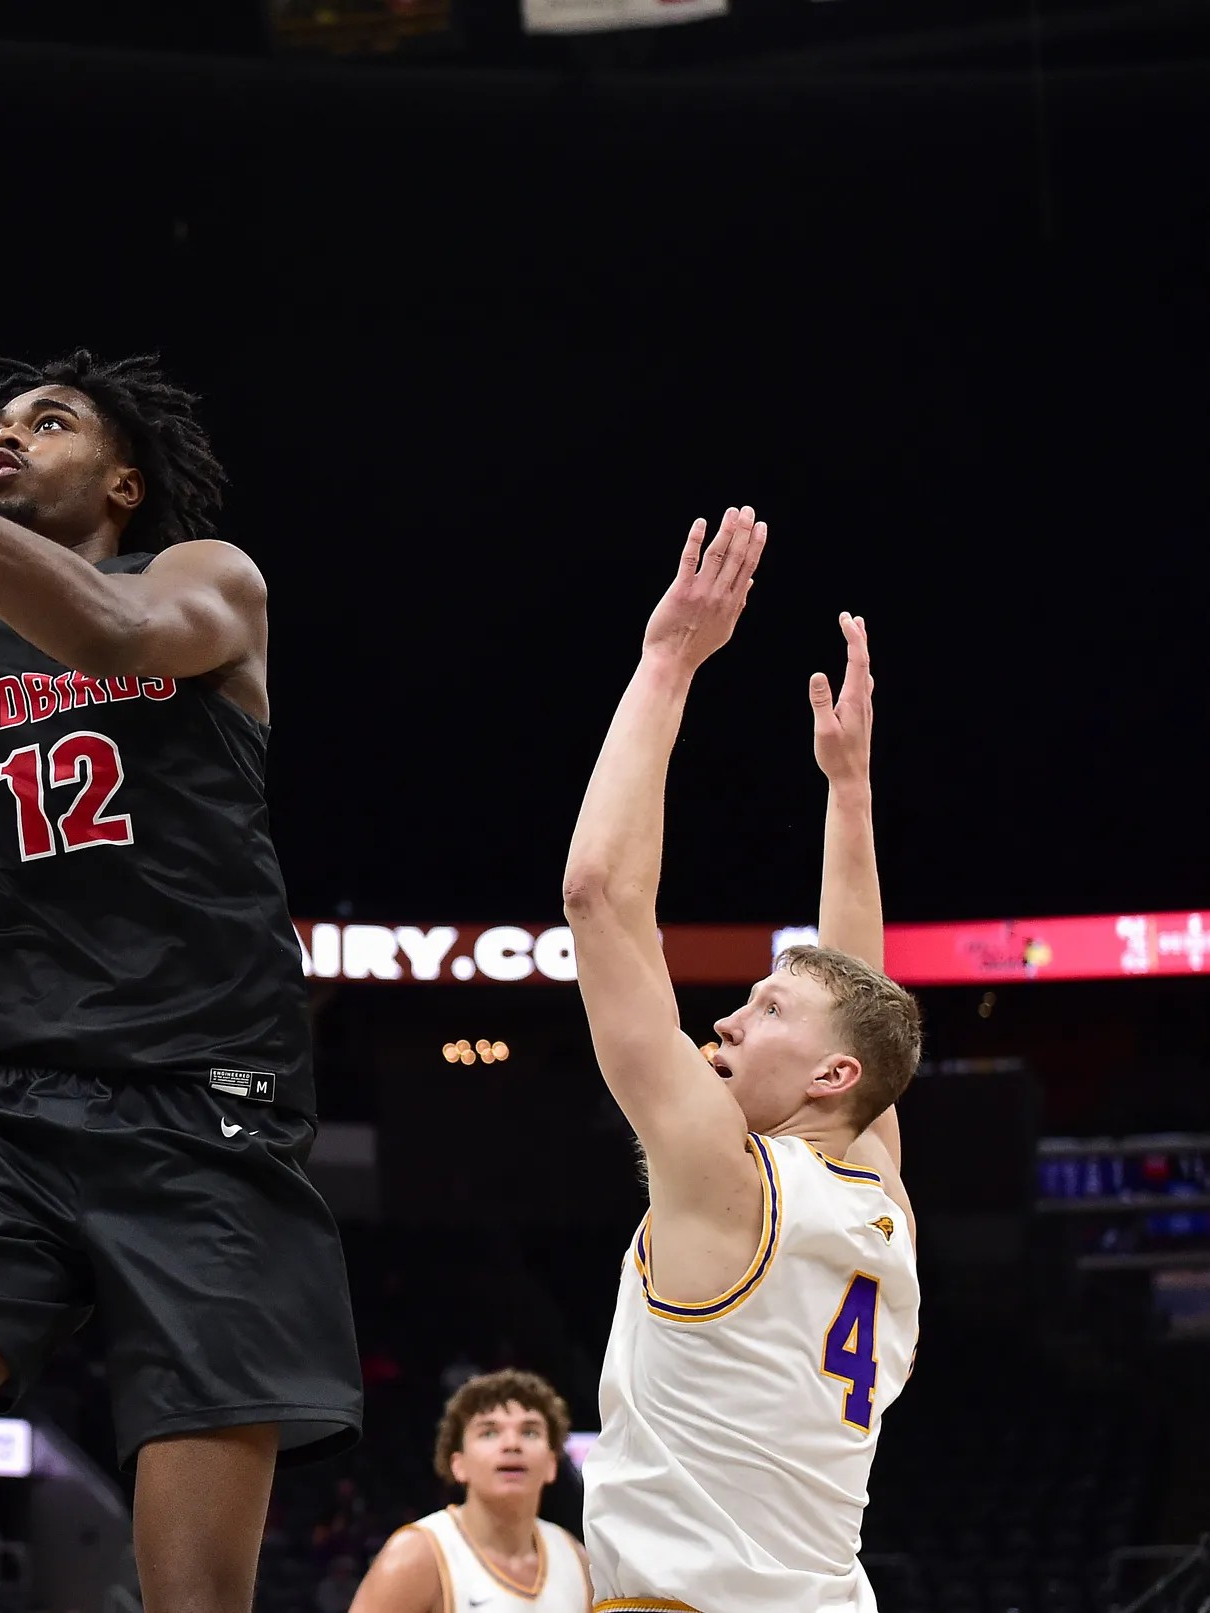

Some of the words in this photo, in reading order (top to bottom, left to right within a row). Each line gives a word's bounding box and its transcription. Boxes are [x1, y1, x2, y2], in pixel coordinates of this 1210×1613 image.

[292, 922, 580, 981] IRY.CO
[256, 1080, 268, 1094] M
[820, 1269, 881, 1435] 4
